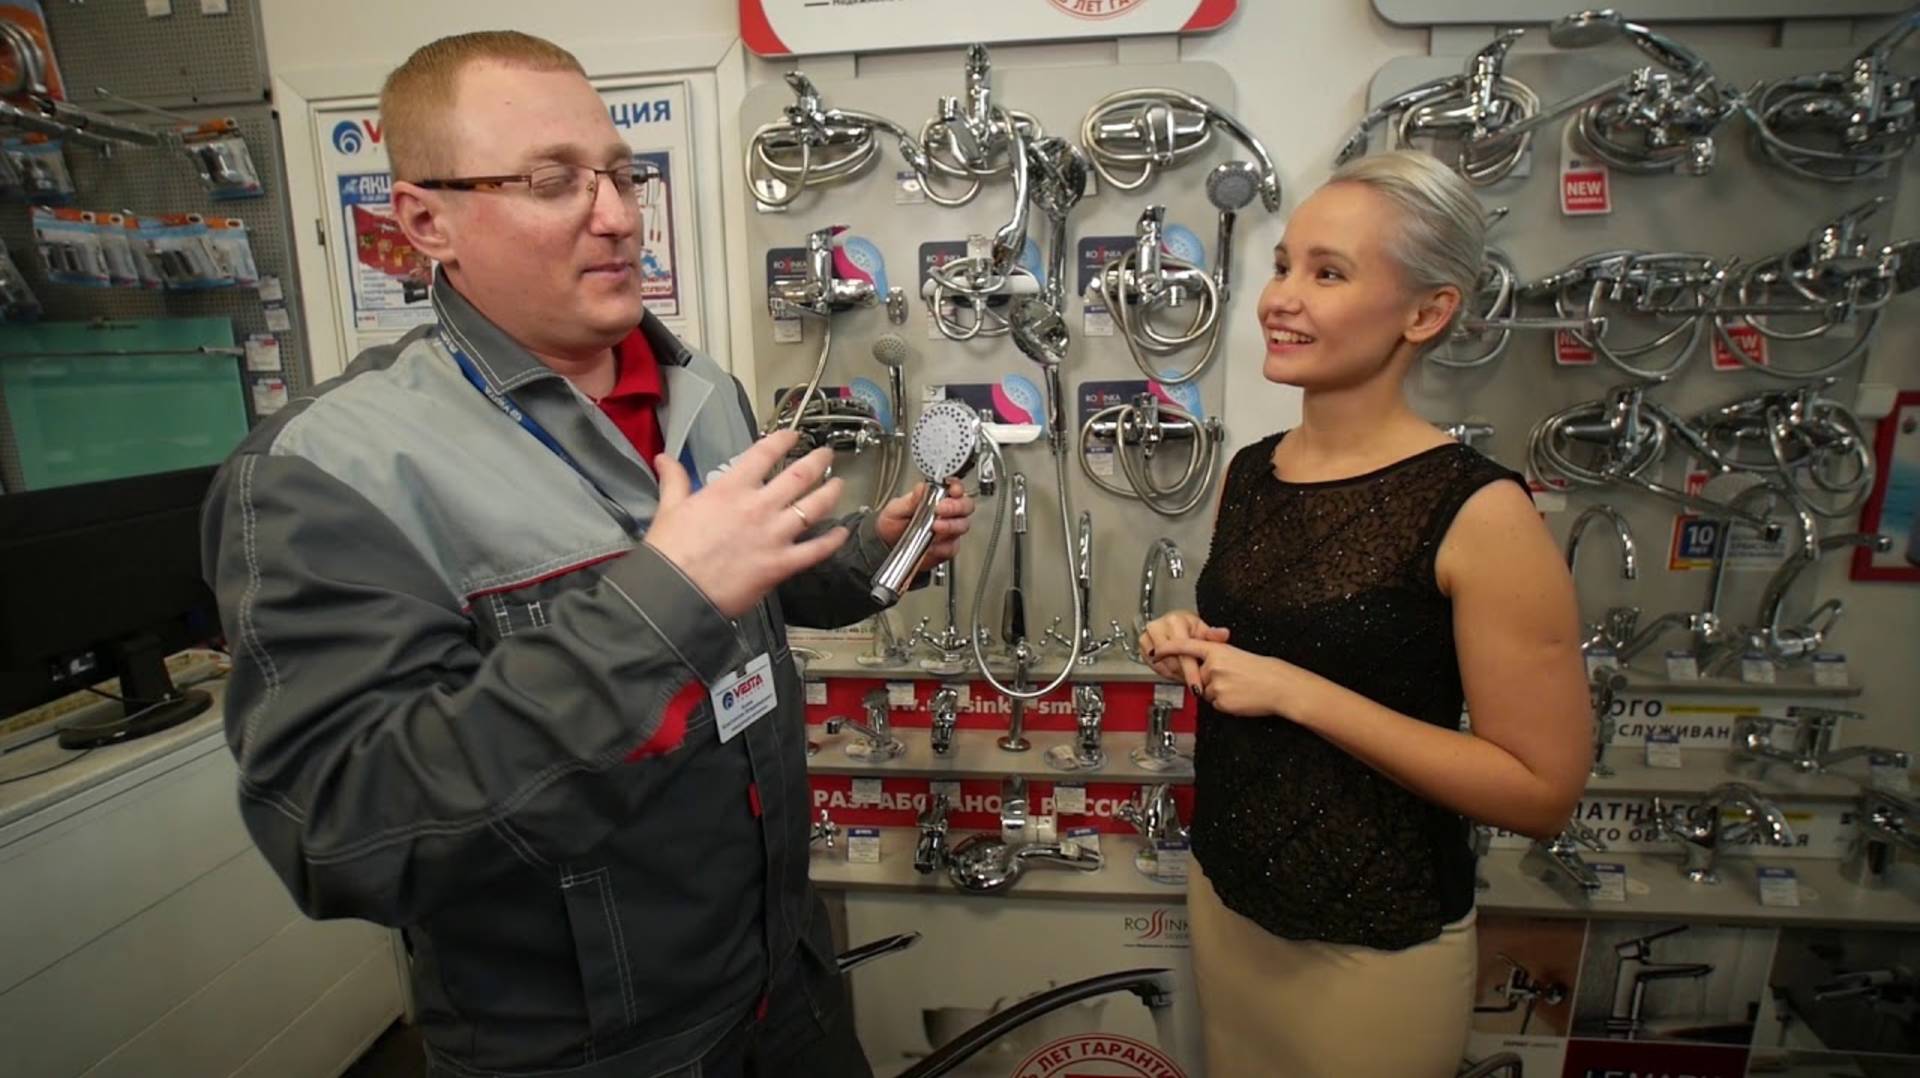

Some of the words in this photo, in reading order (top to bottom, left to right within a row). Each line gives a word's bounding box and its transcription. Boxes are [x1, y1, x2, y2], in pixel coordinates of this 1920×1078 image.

[610, 99, 671, 129] ЦИЯ
[360, 175, 391, 195] АКЦ
[1567, 181, 1602, 196] NEW
[1688, 525, 1715, 545] 10
[733, 674, 763, 697] VESTA
[1037, 1046, 1073, 1073] ЛЕТ
